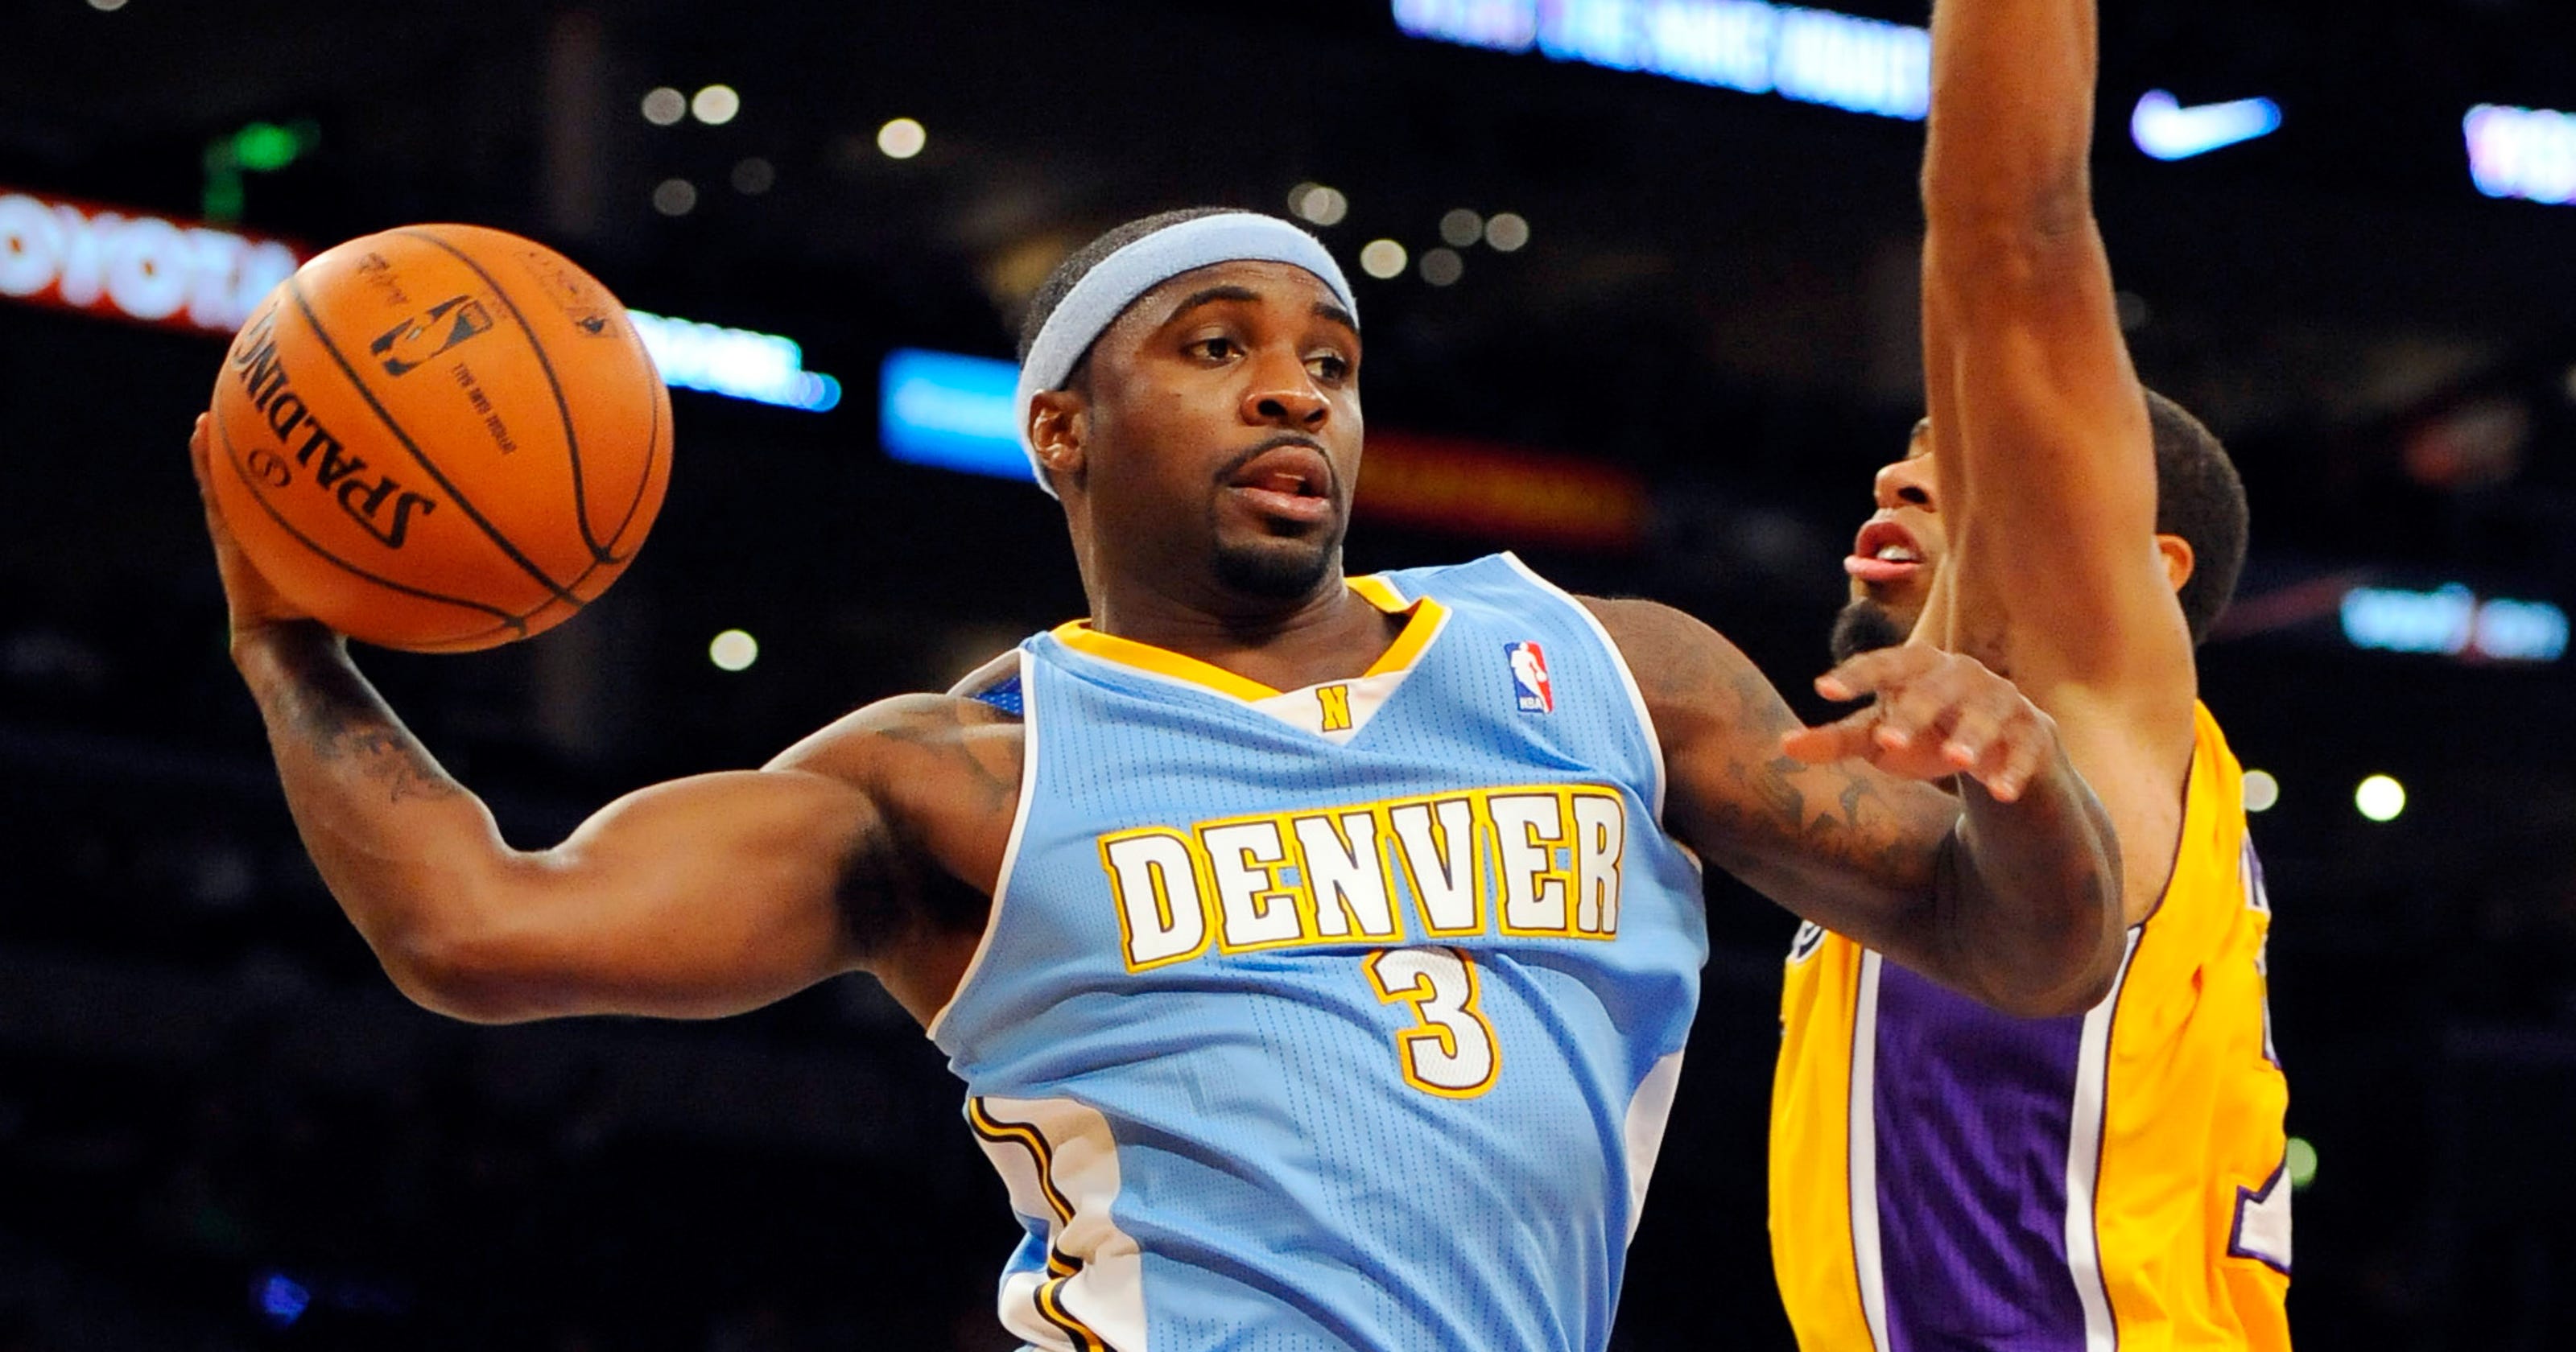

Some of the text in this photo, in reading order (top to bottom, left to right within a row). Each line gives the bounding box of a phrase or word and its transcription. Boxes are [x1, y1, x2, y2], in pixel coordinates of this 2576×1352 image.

[233, 301, 436, 549] SPALDING
[1315, 684, 1352, 732] N
[1098, 784, 1627, 974] DENVER
[1363, 947, 1501, 1099] 3
